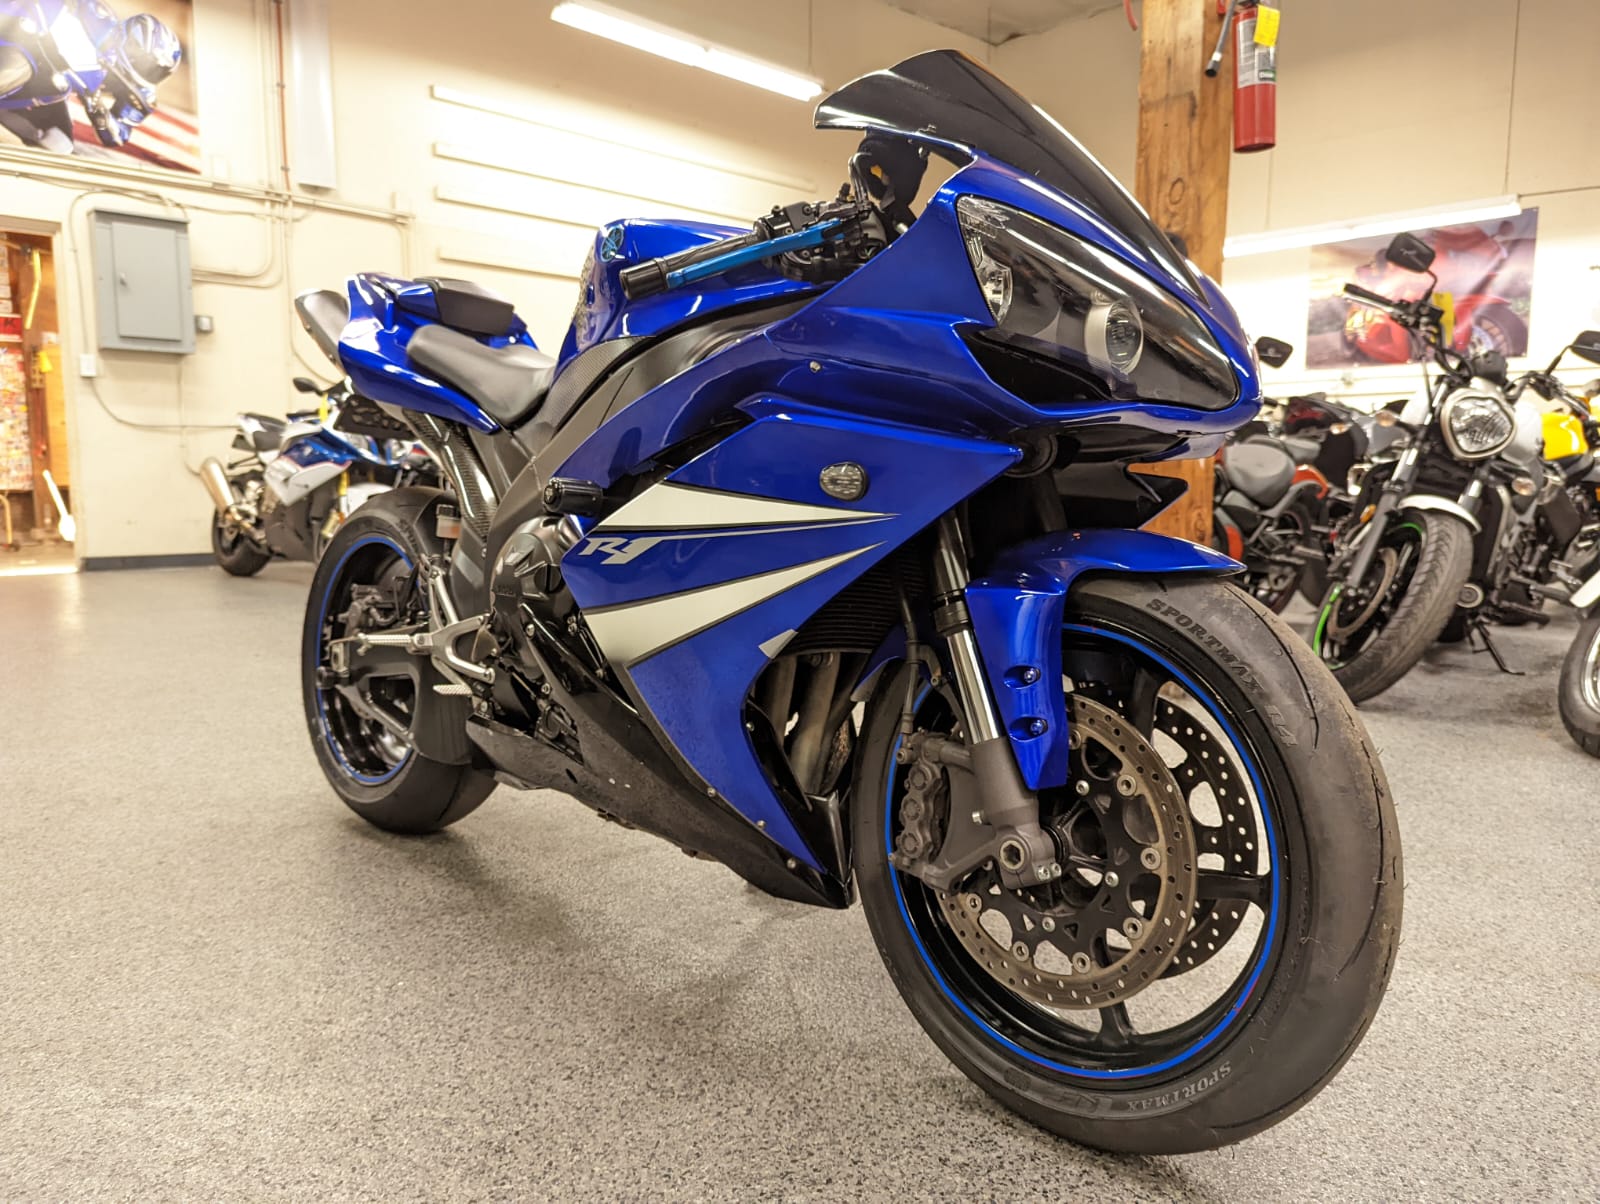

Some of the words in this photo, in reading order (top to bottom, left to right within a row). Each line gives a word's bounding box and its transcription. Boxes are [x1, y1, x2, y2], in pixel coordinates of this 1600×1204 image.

[578, 537, 664, 565] R1
[1146, 598, 1265, 691] SPORTMAX
[1127, 1061, 1231, 1112] SPORTMAX
